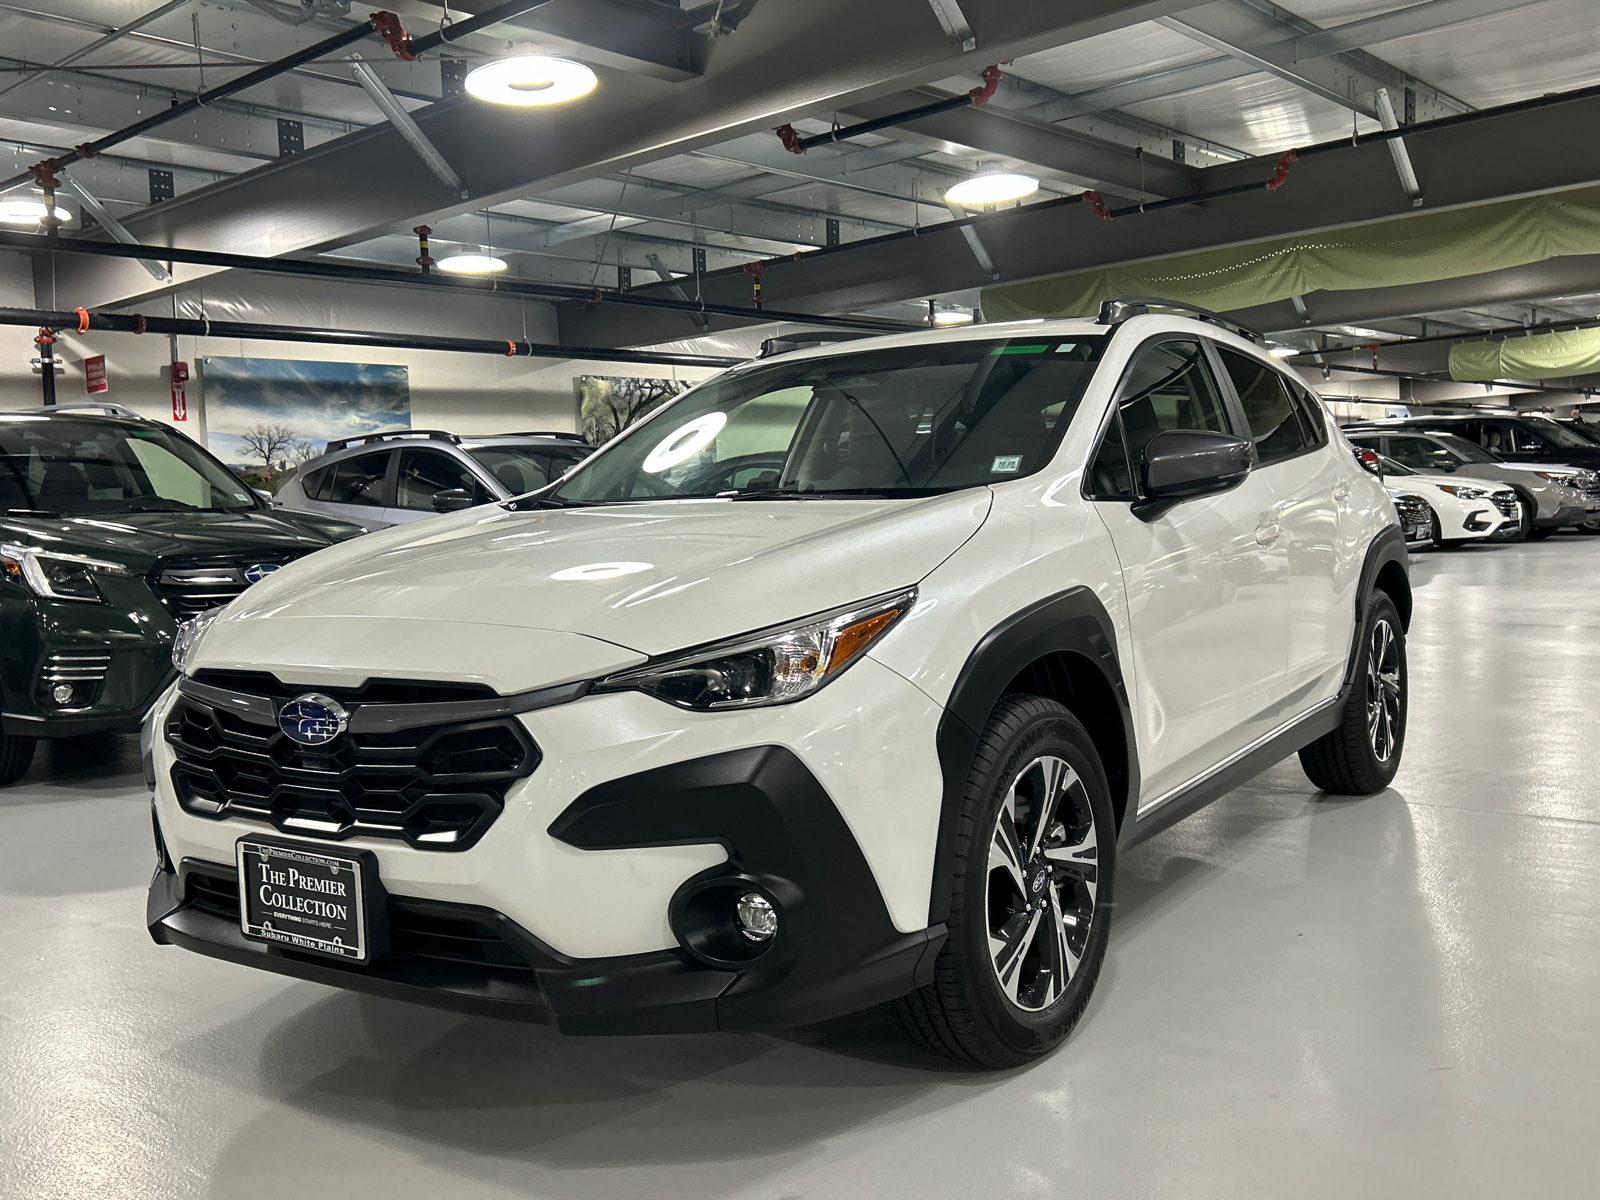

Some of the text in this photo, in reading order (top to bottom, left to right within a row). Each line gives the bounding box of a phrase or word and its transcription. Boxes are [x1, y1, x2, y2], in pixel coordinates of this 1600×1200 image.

[992, 726, 1044, 800] YOKOHAMA
[258, 863, 347, 897] THE PREMIER
[259, 884, 348, 921] COLLECTION
[273, 911, 302, 923] EVERYTHING
[302, 918, 319, 927] STARTS
[260, 929, 345, 955] Subaru White Plains
